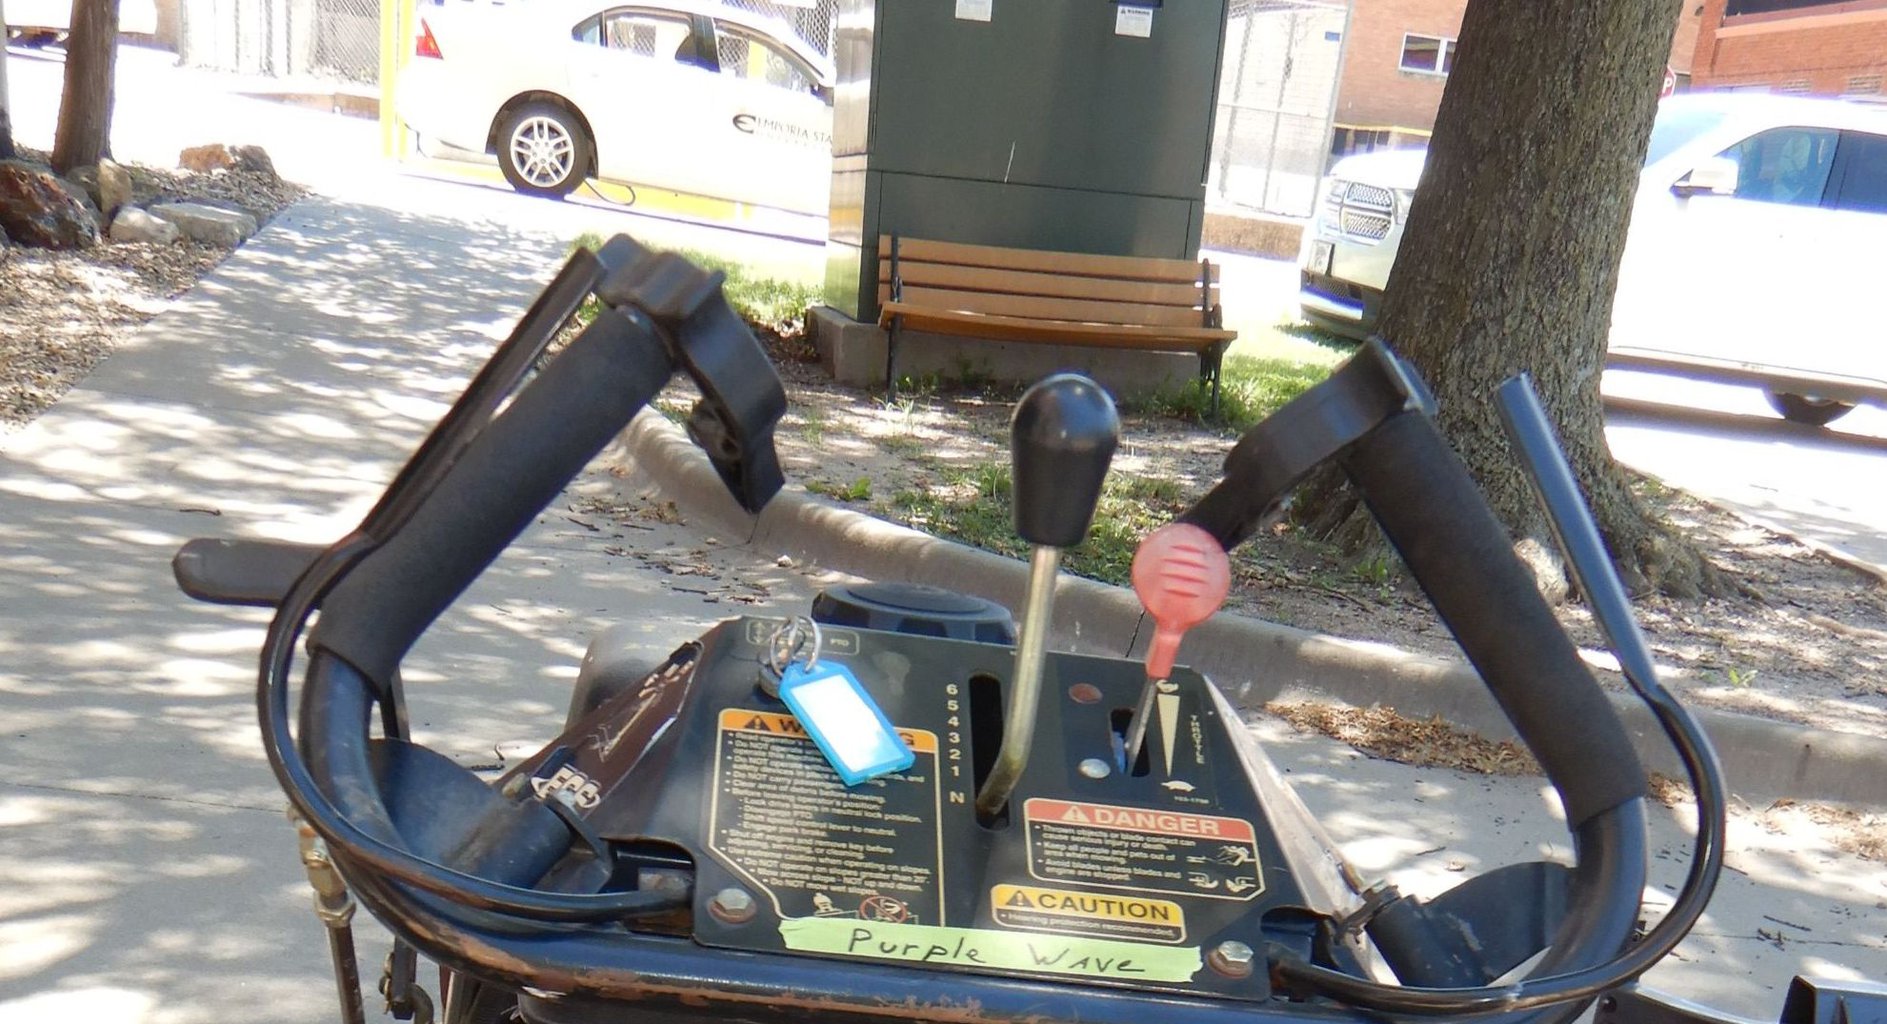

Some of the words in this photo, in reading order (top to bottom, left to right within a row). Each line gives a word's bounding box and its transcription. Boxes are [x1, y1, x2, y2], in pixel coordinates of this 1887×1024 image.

[946, 684, 958, 695] 6
[948, 700, 959, 711] 5
[948, 716, 959, 727] 4
[949, 732, 960, 743] 3
[950, 749, 961, 760] 2
[748, 772, 768, 780] NOT
[952, 766, 960, 777] 1
[950, 791, 965, 804] N
[1094, 808, 1219, 835] DANGER
[758, 859, 779, 867] NOT
[785, 879, 805, 888] NOT
[1038, 894, 1170, 921] CAUTION
[1008, 913, 1047, 925] Hearing
[1050, 917, 1100, 929] protection
[848, 927, 987, 963] Purple
